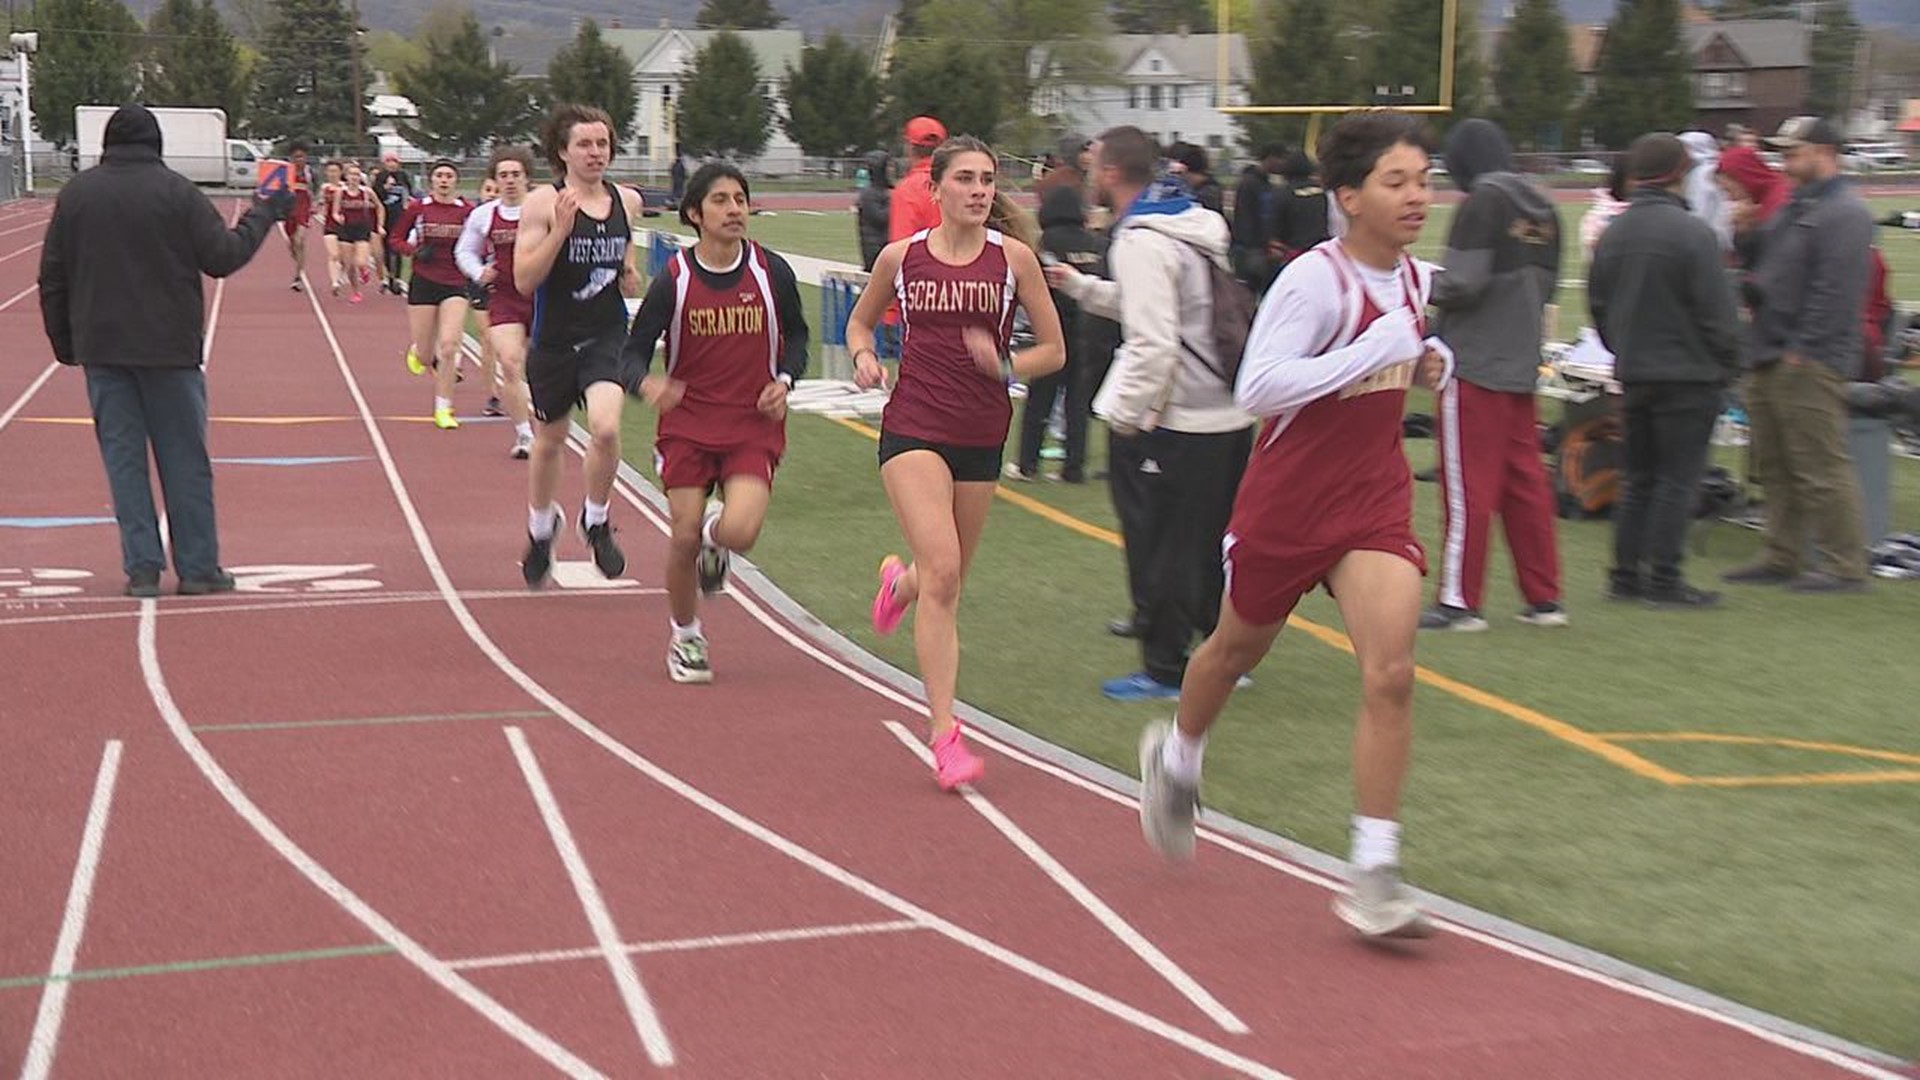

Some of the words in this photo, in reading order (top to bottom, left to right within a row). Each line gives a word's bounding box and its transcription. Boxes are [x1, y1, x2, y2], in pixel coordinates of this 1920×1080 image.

[258, 164, 289, 195] 4
[568, 236, 592, 263] WEST
[906, 279, 1000, 313] SCRANTON
[688, 304, 764, 335] SCRANTON
